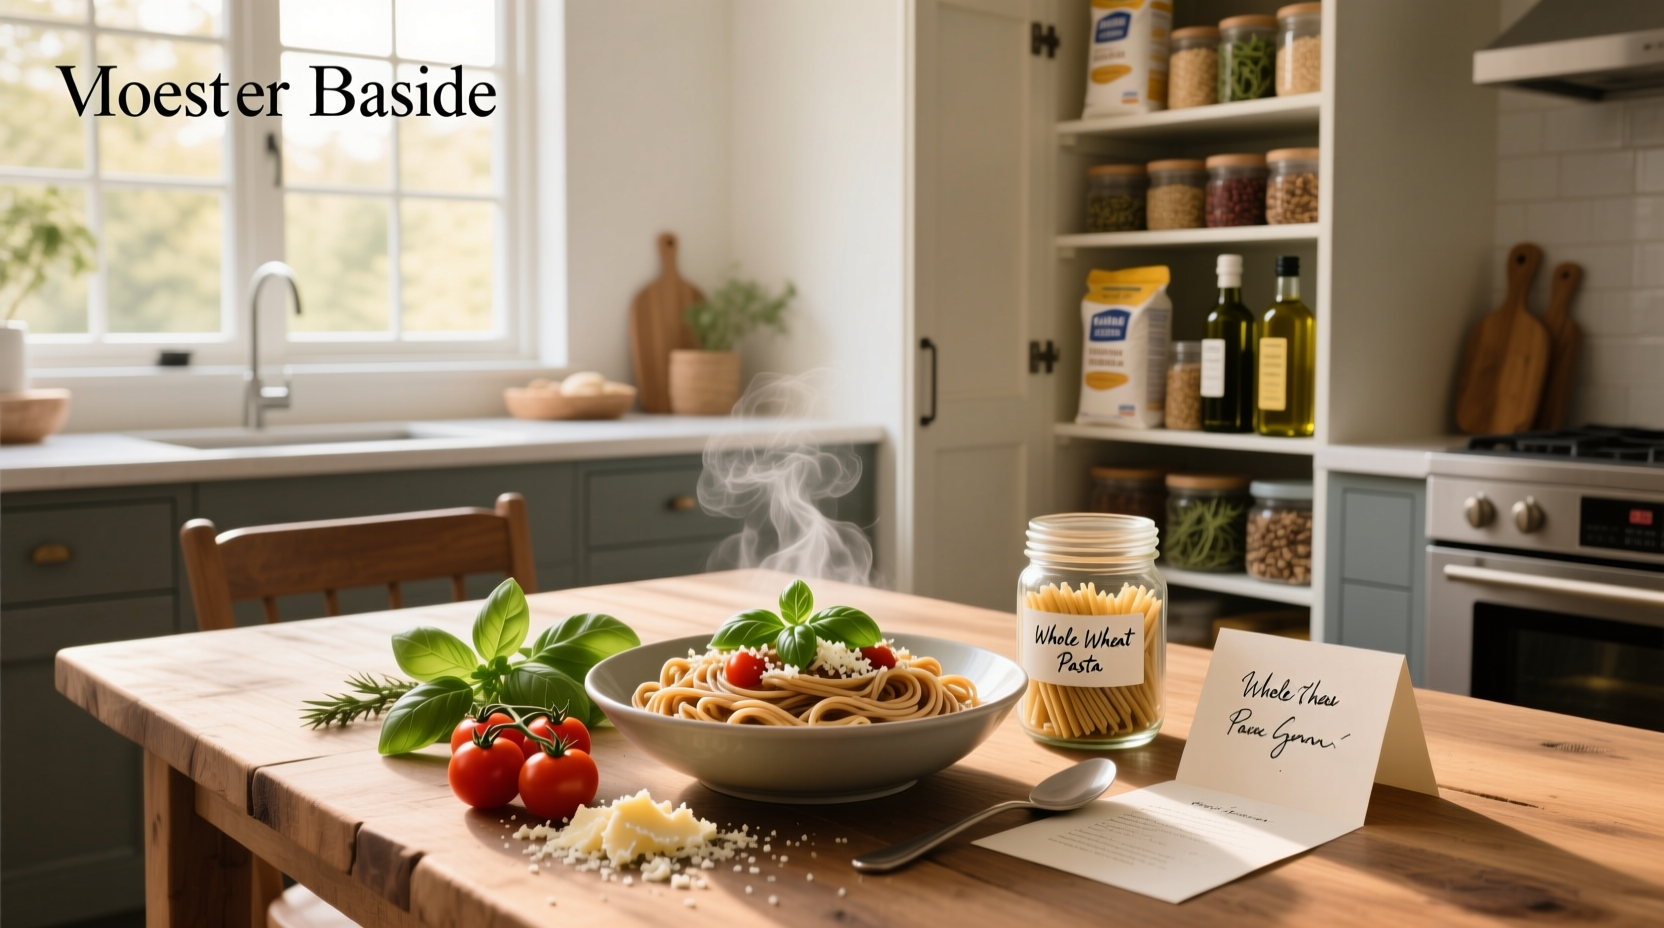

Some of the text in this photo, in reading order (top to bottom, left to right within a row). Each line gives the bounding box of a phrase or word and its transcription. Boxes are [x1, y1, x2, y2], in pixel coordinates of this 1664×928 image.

[1035, 624, 1136, 649] Whole Wheat
[1057, 651, 1103, 673] Pasta
